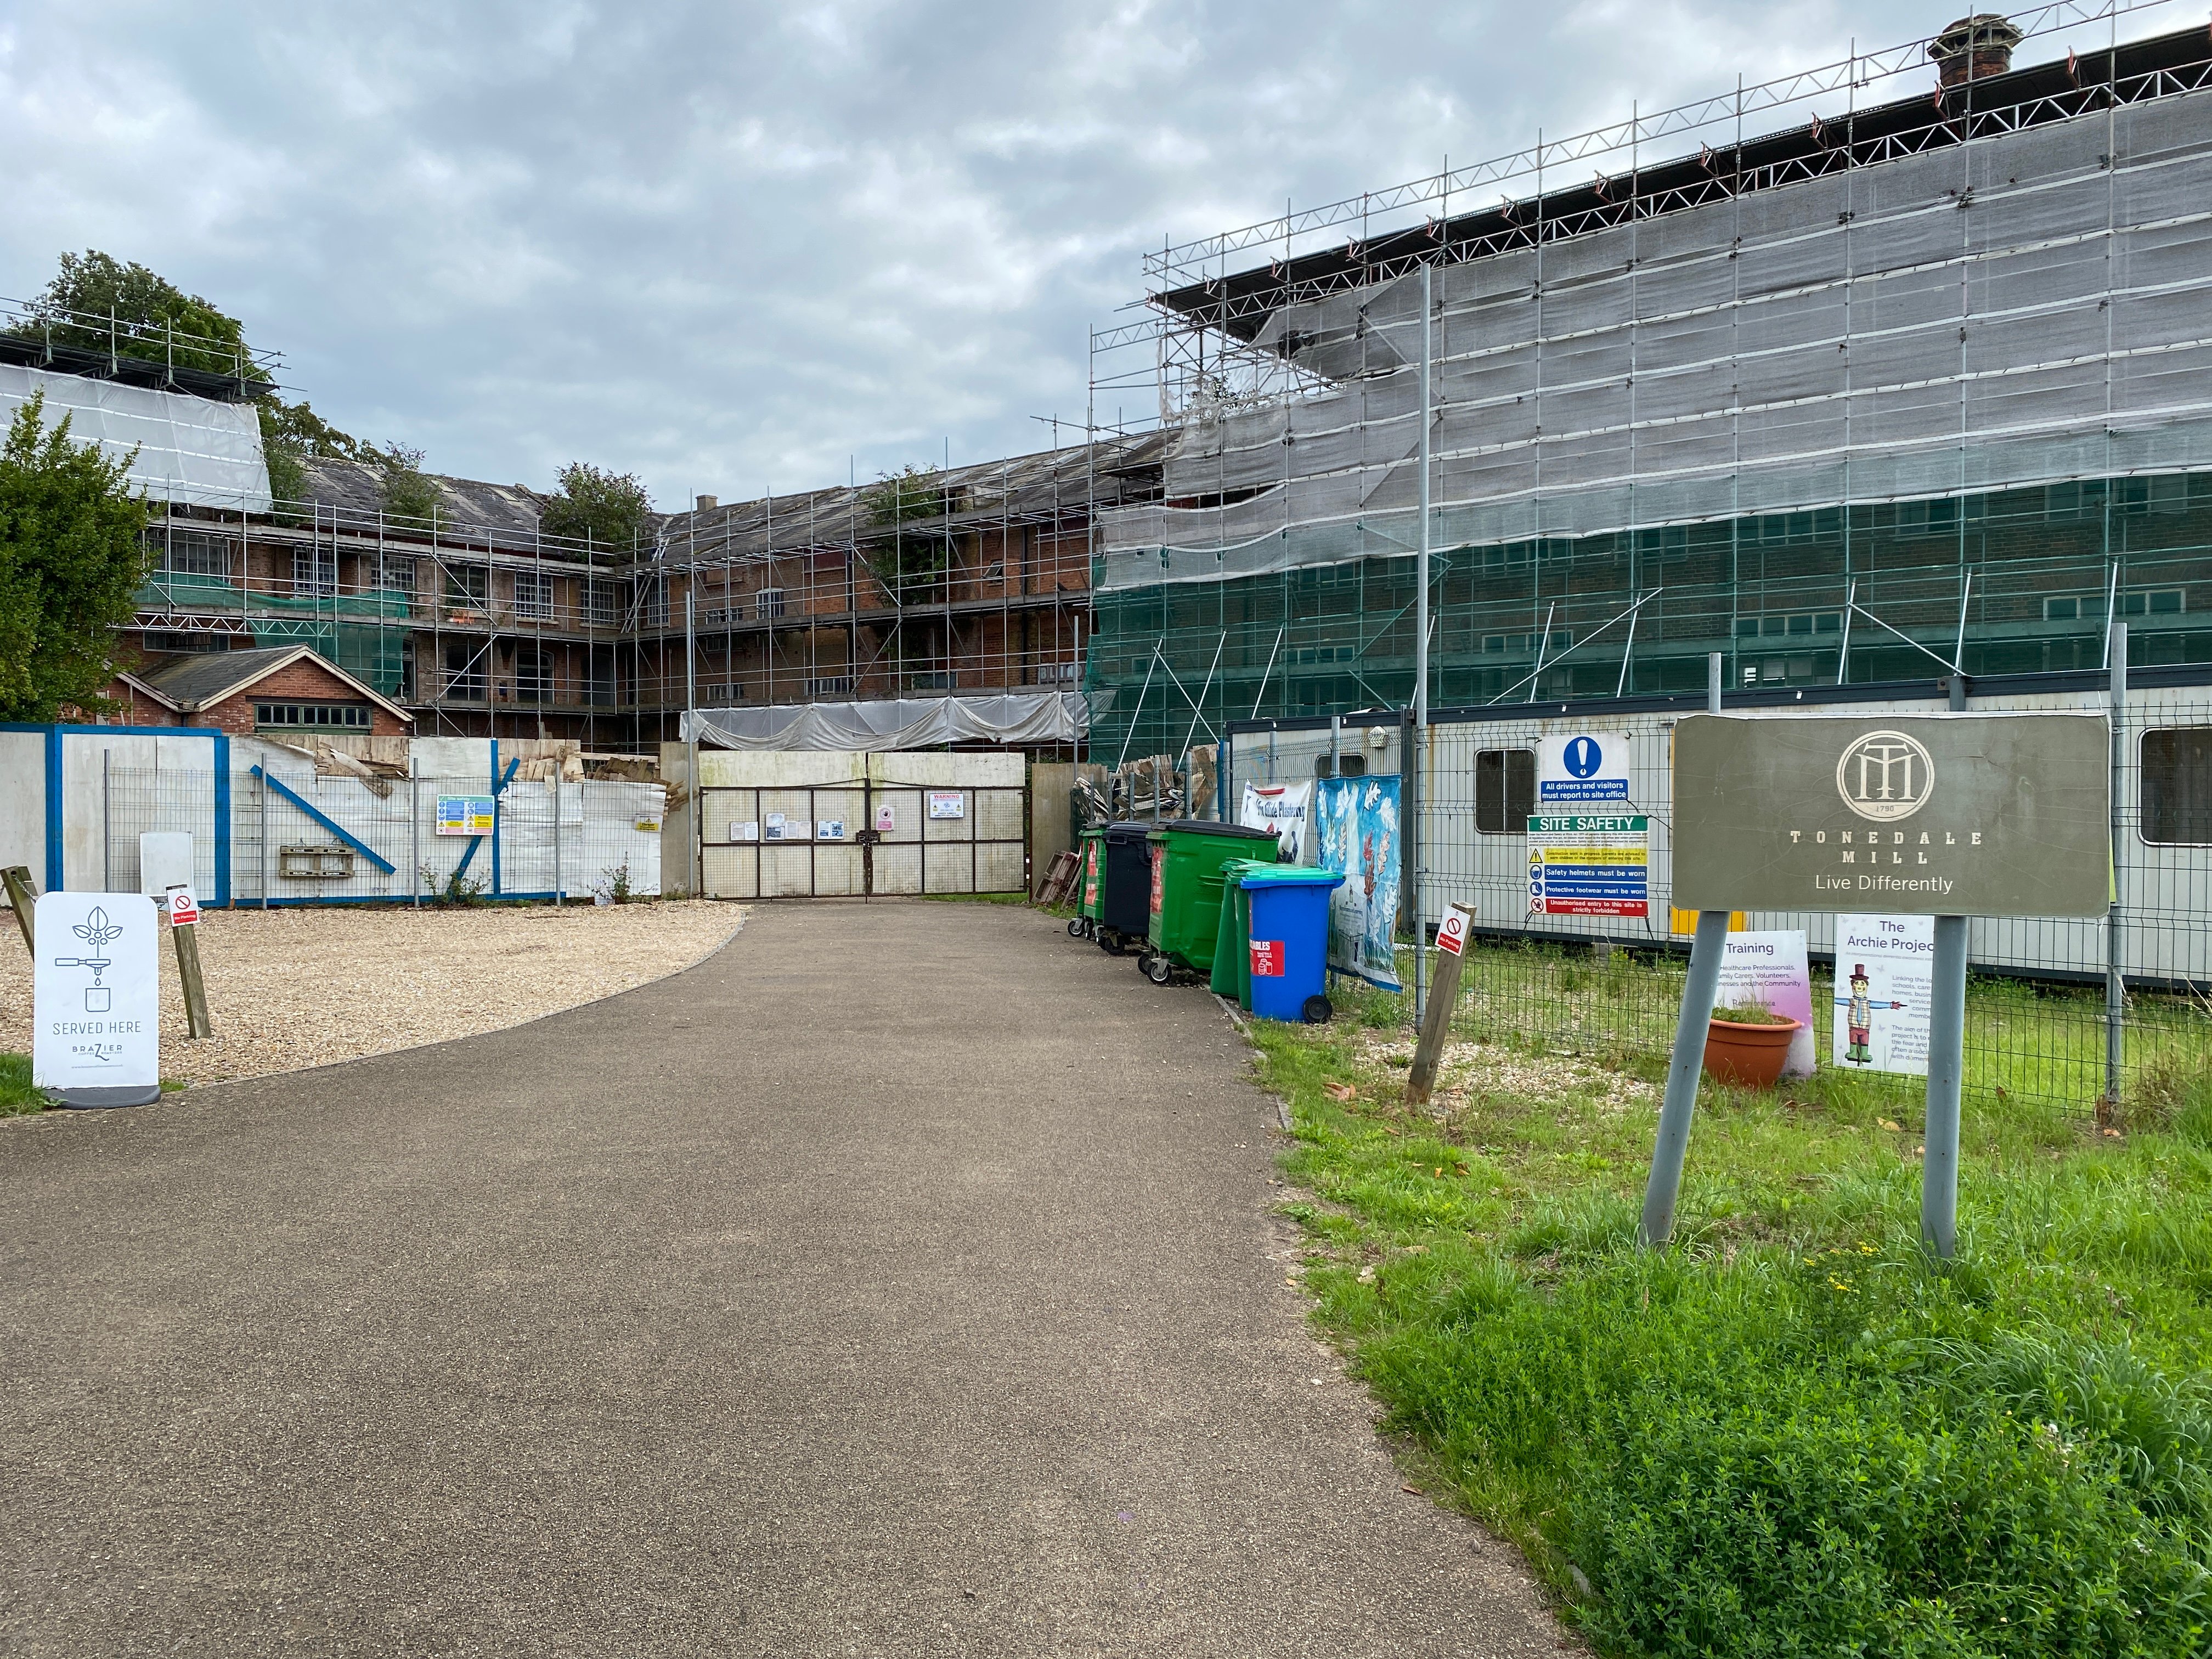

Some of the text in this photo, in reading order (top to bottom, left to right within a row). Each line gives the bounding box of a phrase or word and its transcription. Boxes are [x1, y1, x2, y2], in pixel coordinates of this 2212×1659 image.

[1546, 782, 1555, 791] All
[1556, 782, 1581, 790] drivers
[1597, 781, 1623, 789] visitors
[1560, 792, 1581, 800] report
[1265, 801, 1278, 818] Glide
[1539, 817, 1634, 831] SITE SAFETY
[1790, 831, 1982, 845] TONEDALE
[1842, 851, 1928, 865] MILL
[1546, 868, 1567, 877] Safety
[1815, 874, 1954, 895] Live Differently
[1880, 921, 1905, 933] The
[1445, 939, 1459, 949] Parking
[1725, 943, 1774, 956] Training
[1847, 935, 1934, 953] Archie Projec
[53, 1021, 142, 1035] SERVED HERE
[72, 1043, 122, 1062] BRAZIER
